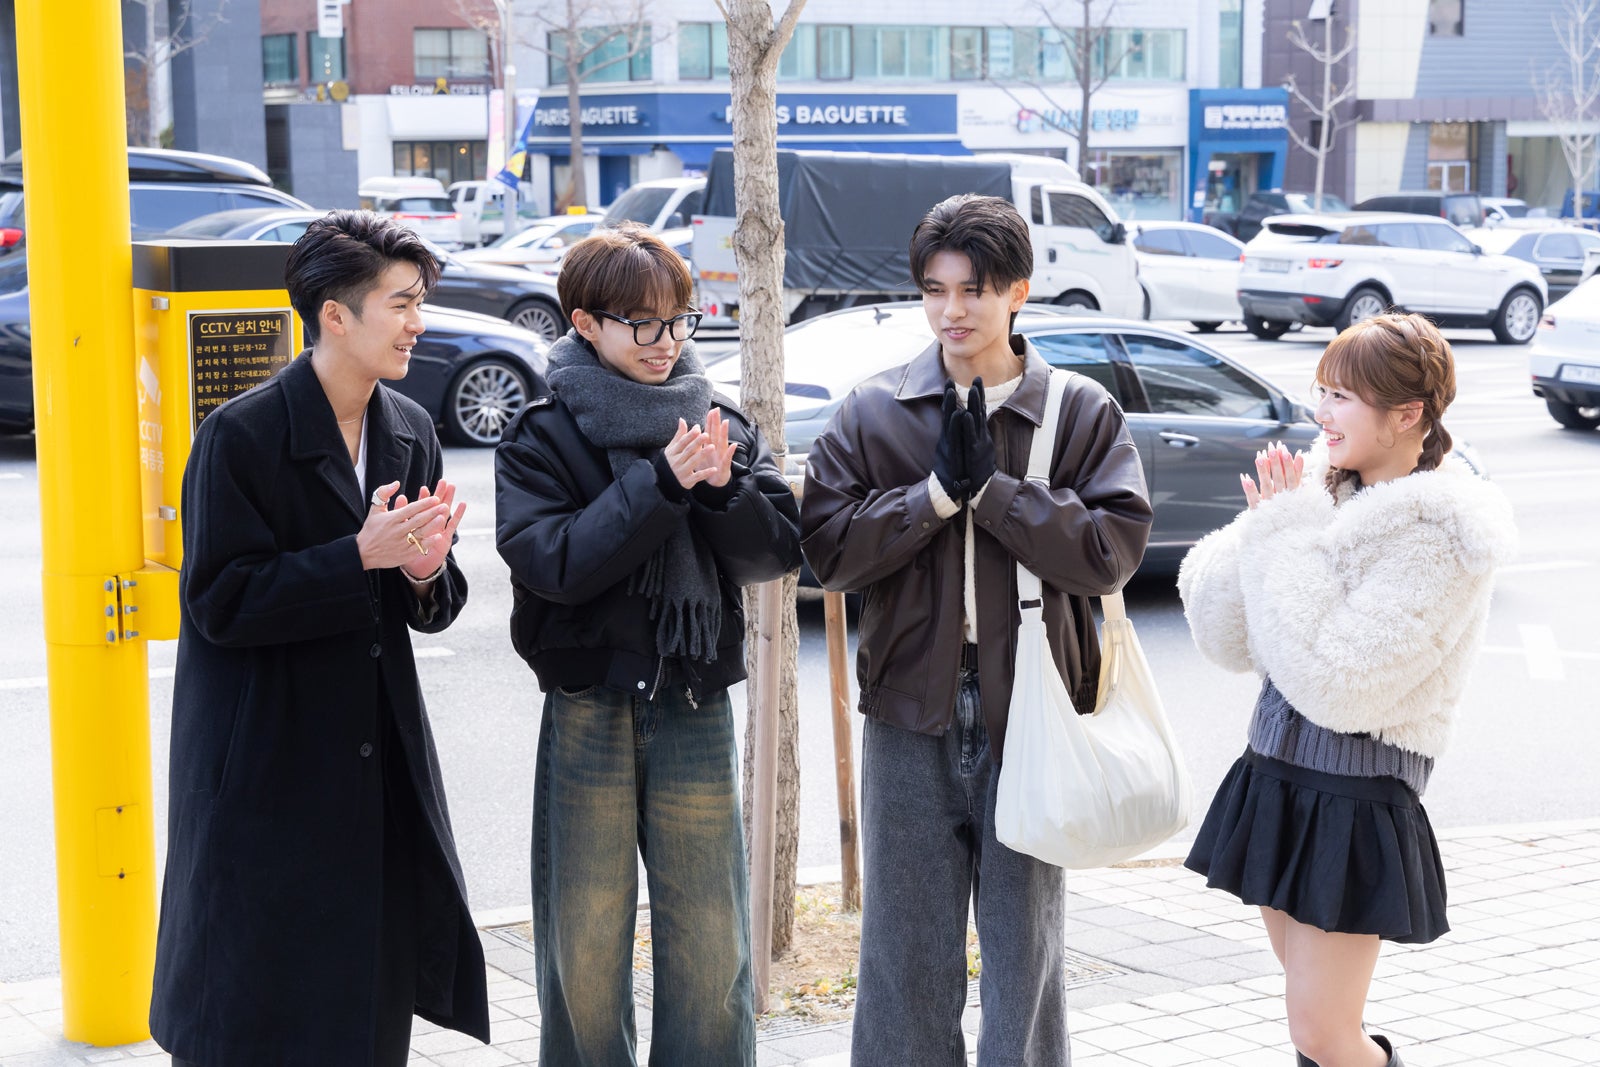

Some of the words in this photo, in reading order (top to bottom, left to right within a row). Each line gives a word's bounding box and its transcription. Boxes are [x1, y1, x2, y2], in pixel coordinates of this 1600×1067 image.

[534, 108, 570, 126] PARIS
[580, 105, 638, 125] AGUETTE
[796, 105, 906, 124] BAGUETTE
[200, 322, 231, 334] CCTV
[235, 320, 257, 334] 설치
[259, 319, 281, 333] 안내
[140, 421, 163, 443] CCTV
